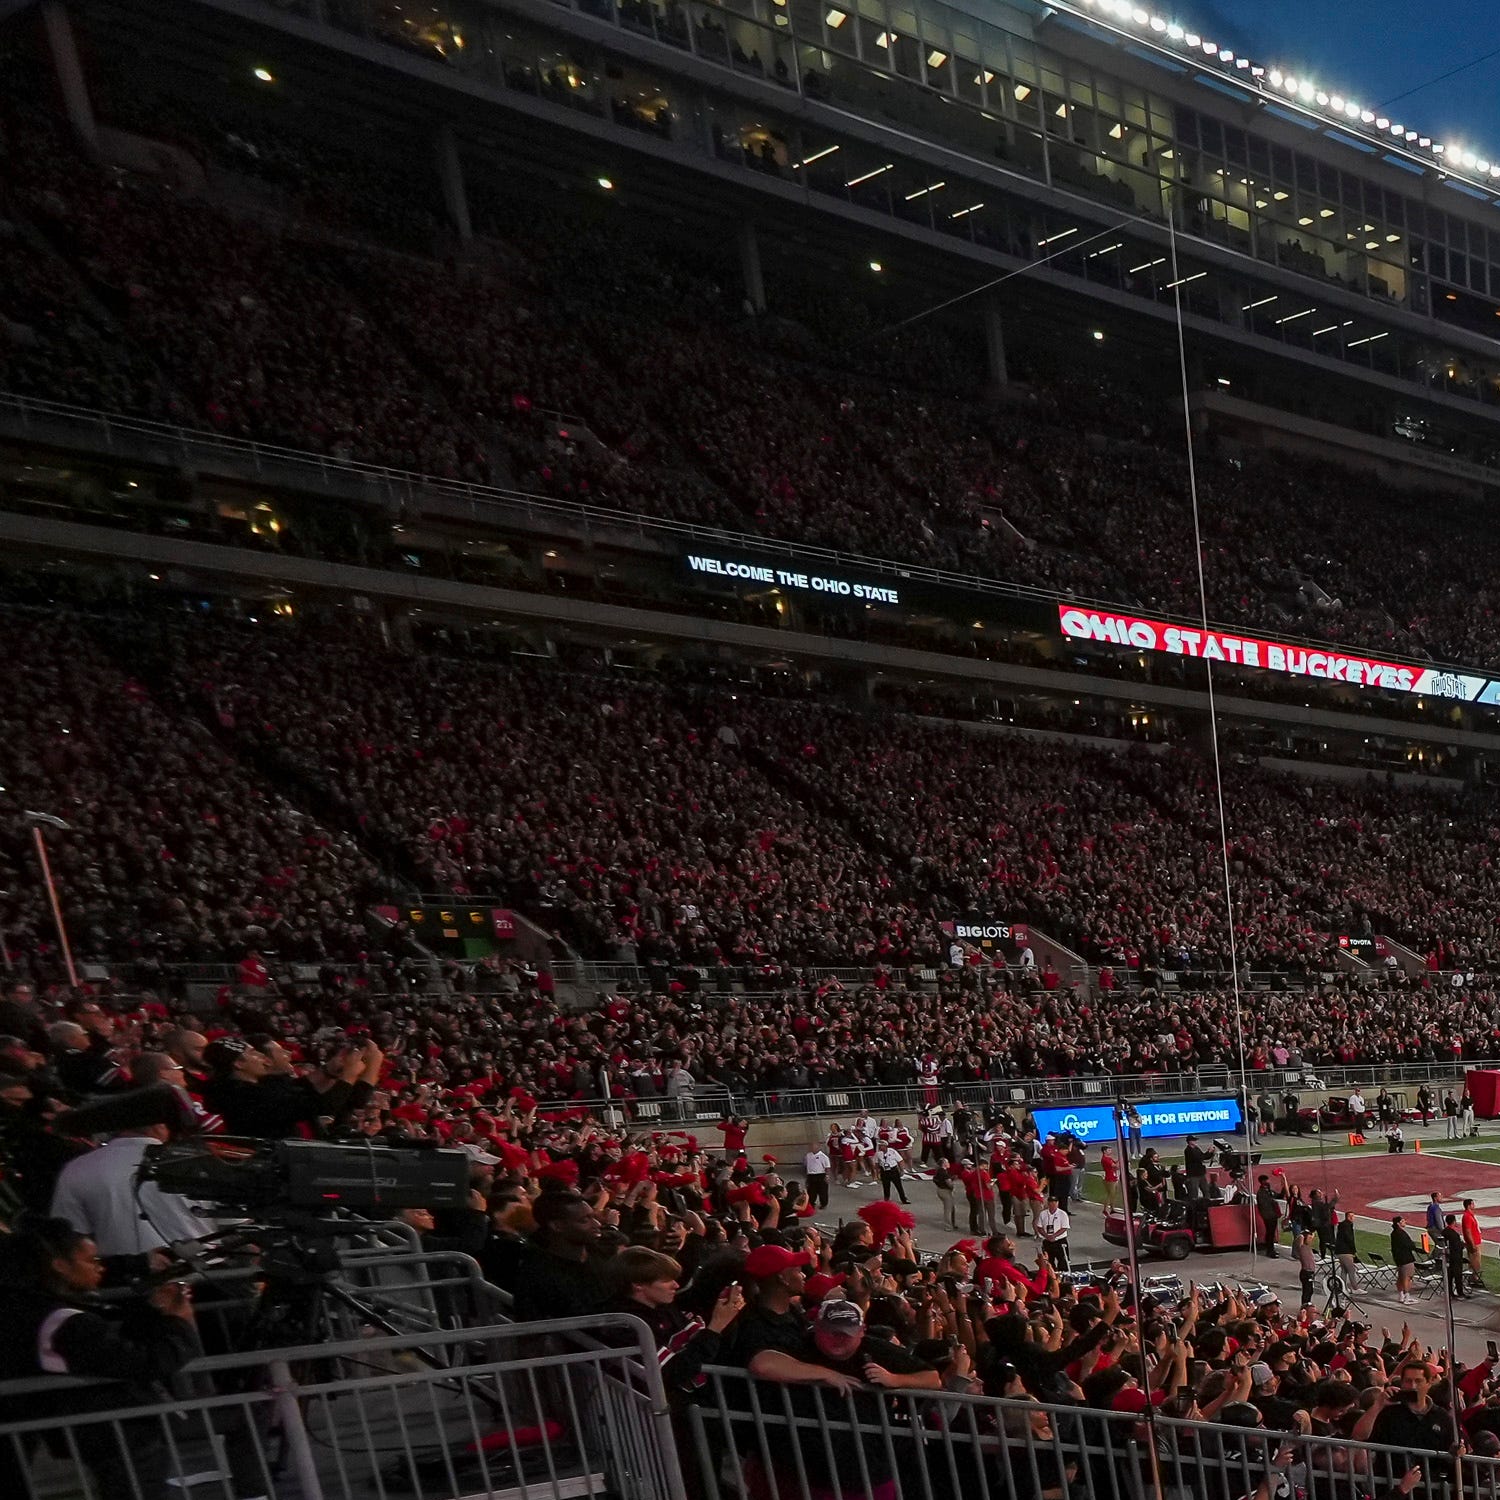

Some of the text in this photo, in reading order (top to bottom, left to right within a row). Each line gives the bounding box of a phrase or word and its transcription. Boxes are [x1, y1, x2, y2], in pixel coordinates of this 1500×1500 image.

[687, 556, 899, 603] WELCOME THE OHIO STATE
[1061, 610, 1414, 691] OHIO STATE BUCKEYES
[1060, 1114, 1098, 1136] Kroger
[1155, 1114, 1176, 1125] FOR
[1178, 1110, 1230, 1123] EVERYONE
